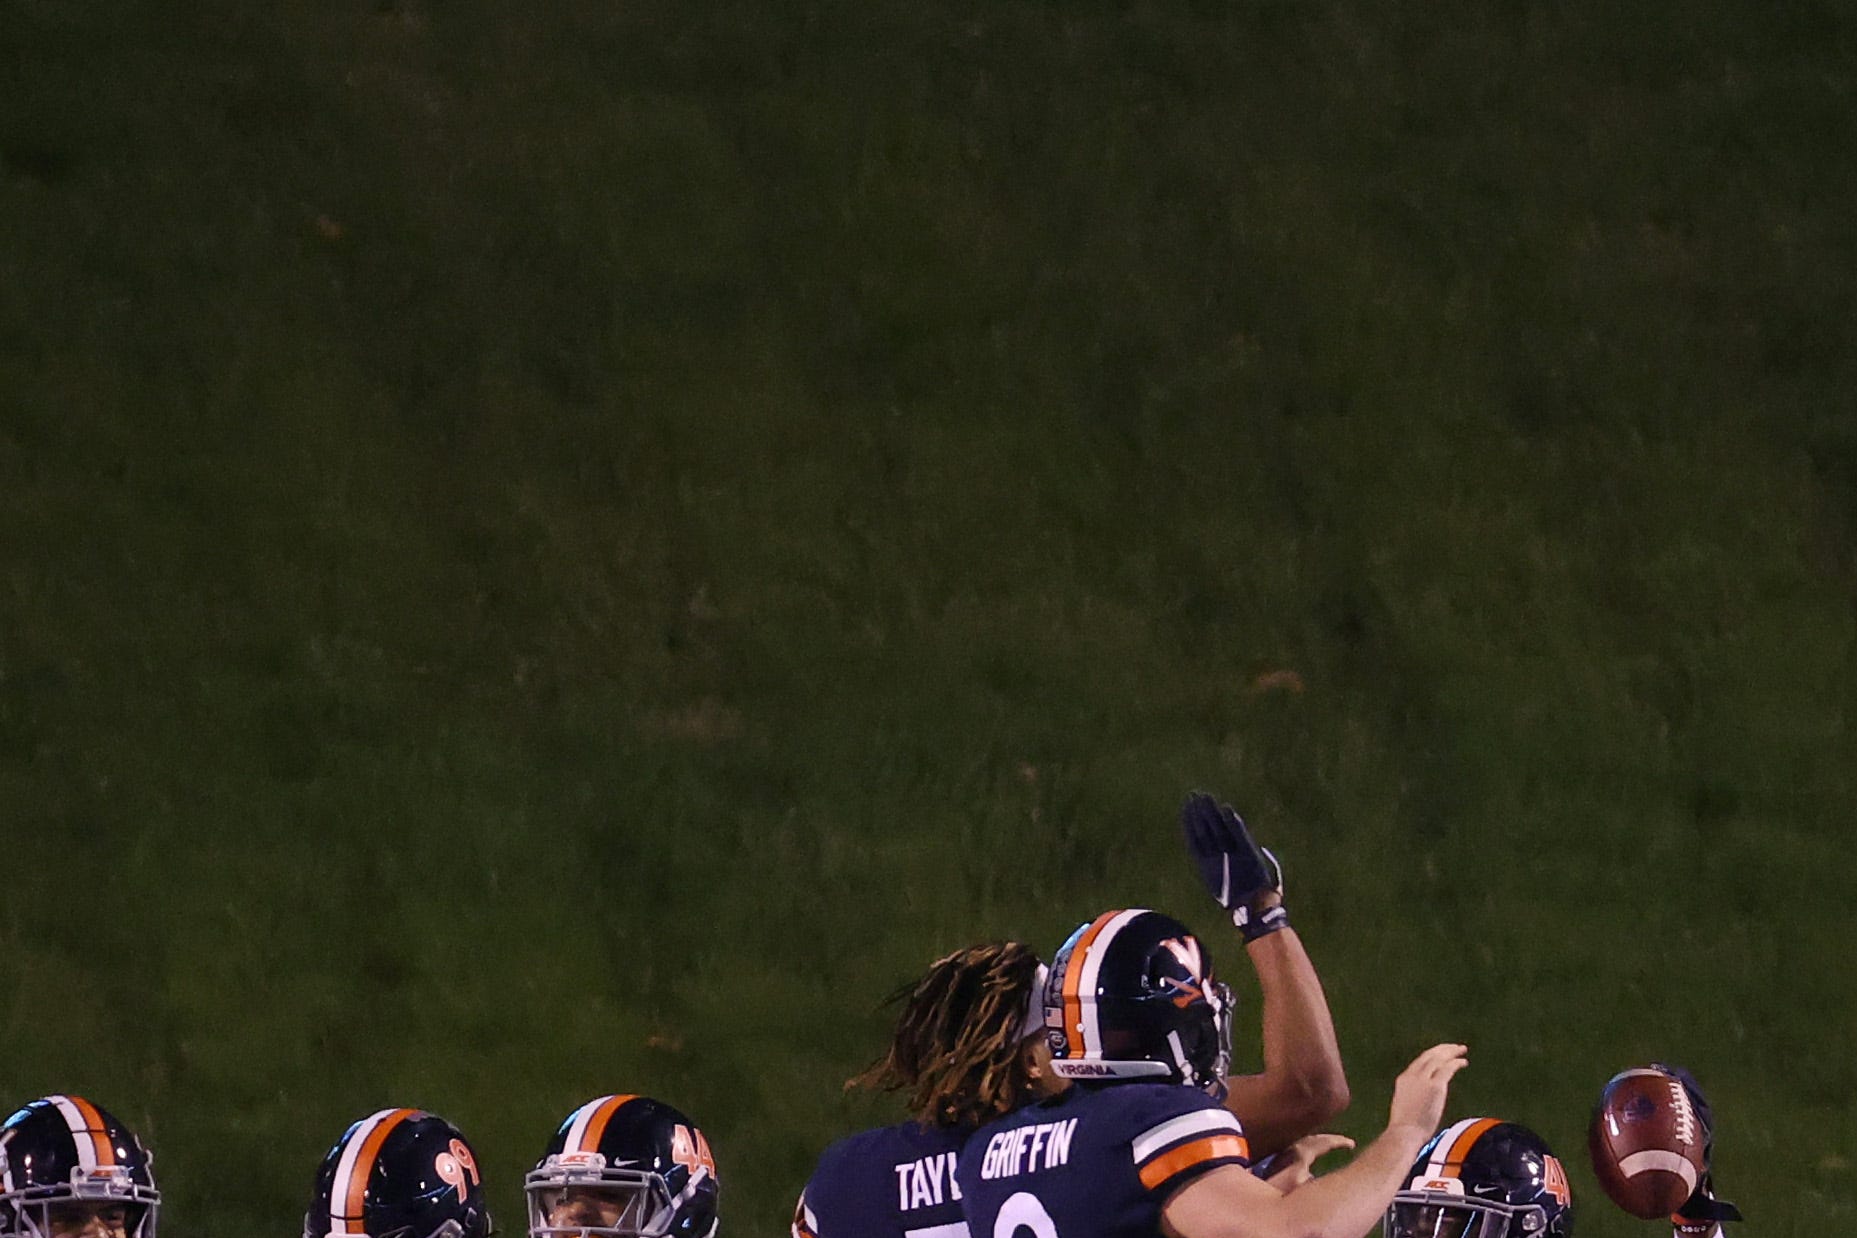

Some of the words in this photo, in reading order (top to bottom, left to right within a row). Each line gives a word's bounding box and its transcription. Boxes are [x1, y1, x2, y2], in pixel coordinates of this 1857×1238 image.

[1059, 1064, 1116, 1076] VIRGINIA
[434, 1137, 480, 1205] 99
[671, 1123, 716, 1180] 44
[981, 1117, 1078, 1180] GRIFFIN
[1543, 1153, 1571, 1208] 41
